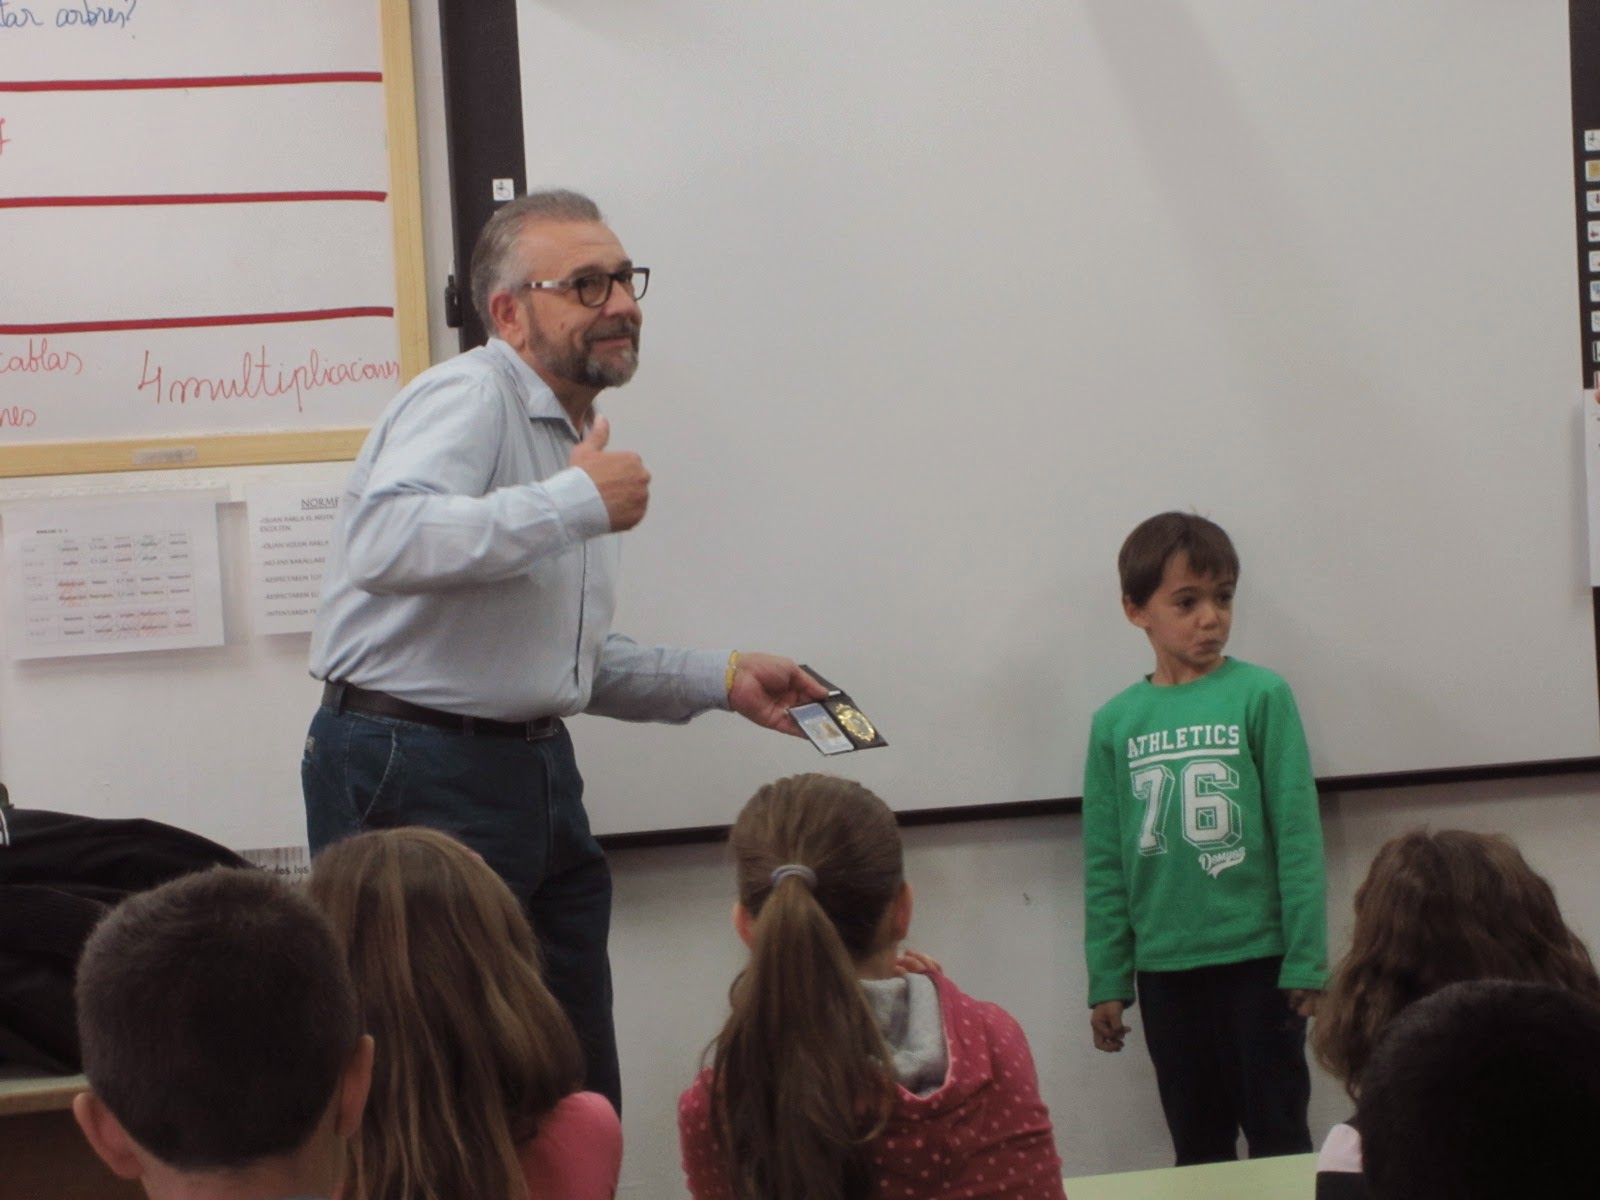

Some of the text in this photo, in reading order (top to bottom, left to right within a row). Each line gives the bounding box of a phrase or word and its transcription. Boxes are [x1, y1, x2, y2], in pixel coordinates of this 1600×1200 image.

[0, 337, 83, 375] ablas
[137, 349, 162, 404] 4
[1127, 724, 1240, 759] ATHLETICS
[1130, 759, 1243, 857] 76
